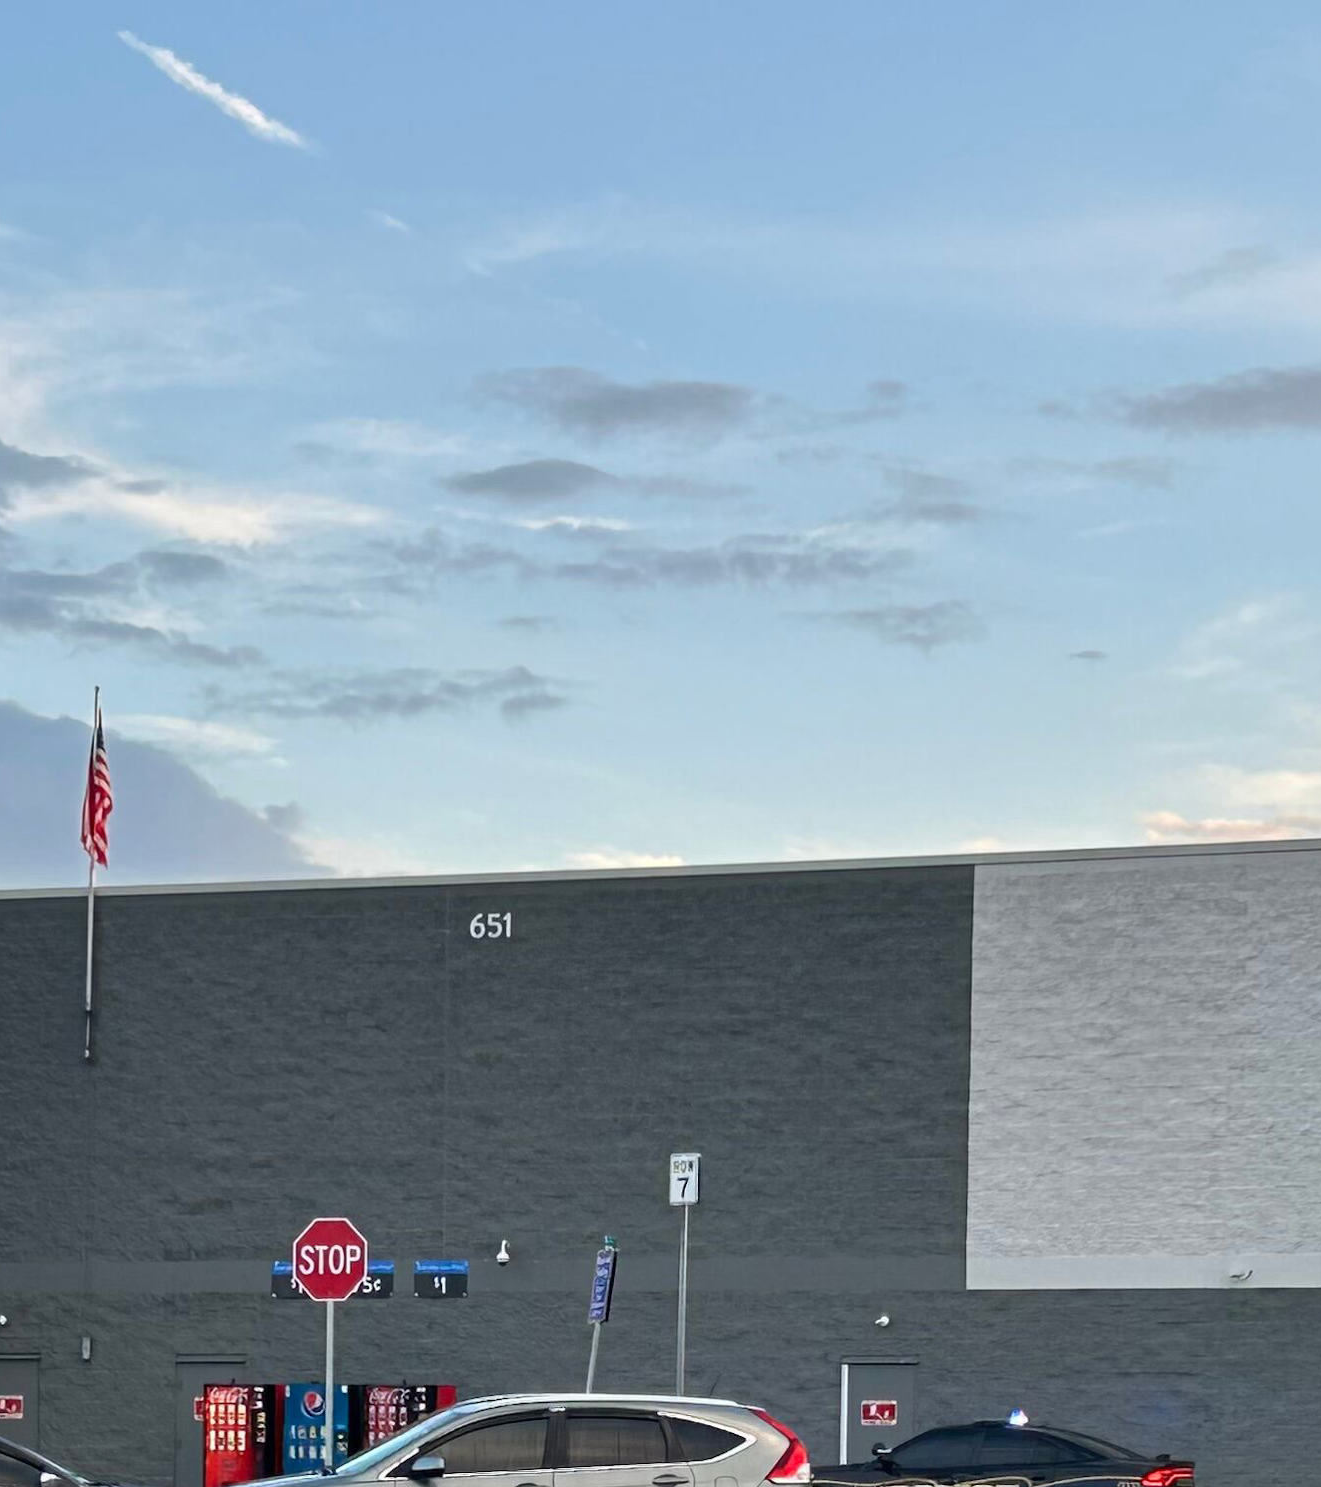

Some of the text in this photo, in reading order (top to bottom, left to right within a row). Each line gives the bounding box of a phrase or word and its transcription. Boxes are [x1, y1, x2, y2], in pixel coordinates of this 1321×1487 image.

[469, 912, 512, 939] 651
[677, 1176, 689, 1199] 7
[299, 1245, 362, 1275] STOP
